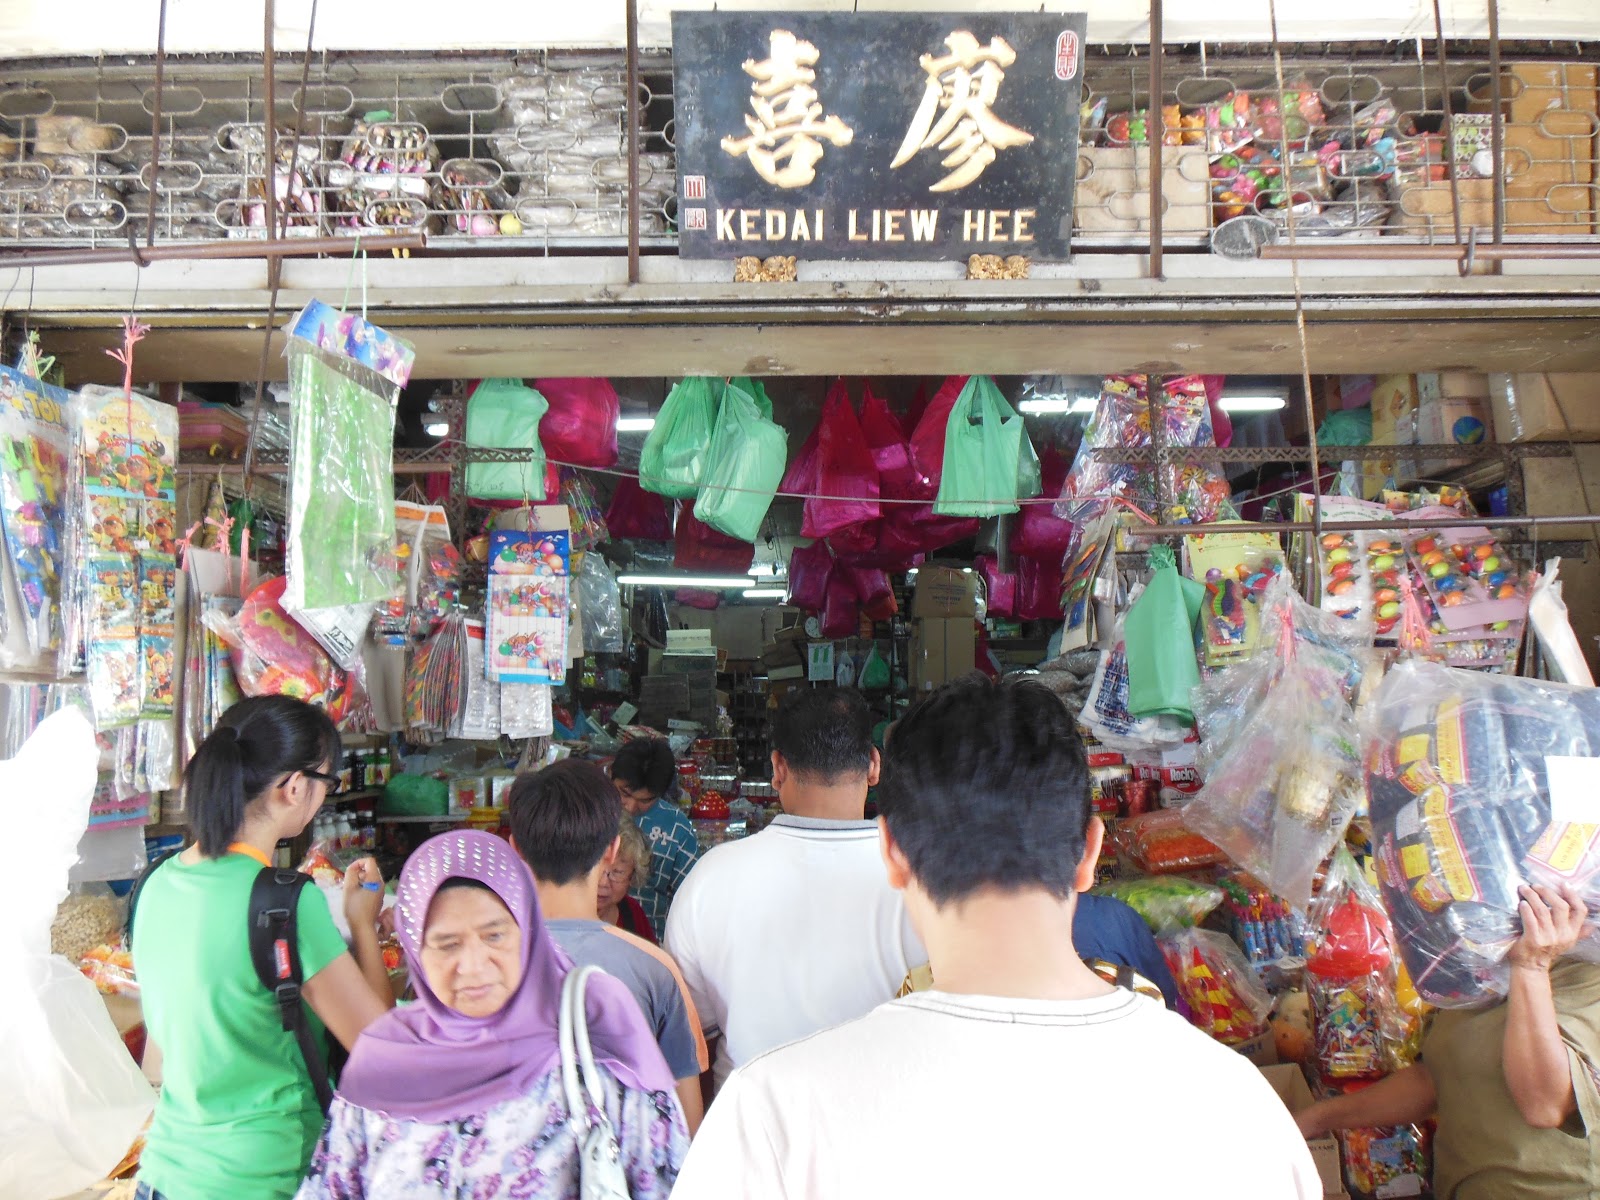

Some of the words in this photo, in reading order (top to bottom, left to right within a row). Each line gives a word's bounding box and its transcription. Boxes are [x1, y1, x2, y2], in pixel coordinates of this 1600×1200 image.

[716, 208, 824, 242] KEDAI
[848, 208, 939, 242] LIEW
[963, 208, 1035, 242] HEE
[1170, 767, 1195, 782] Rocky
